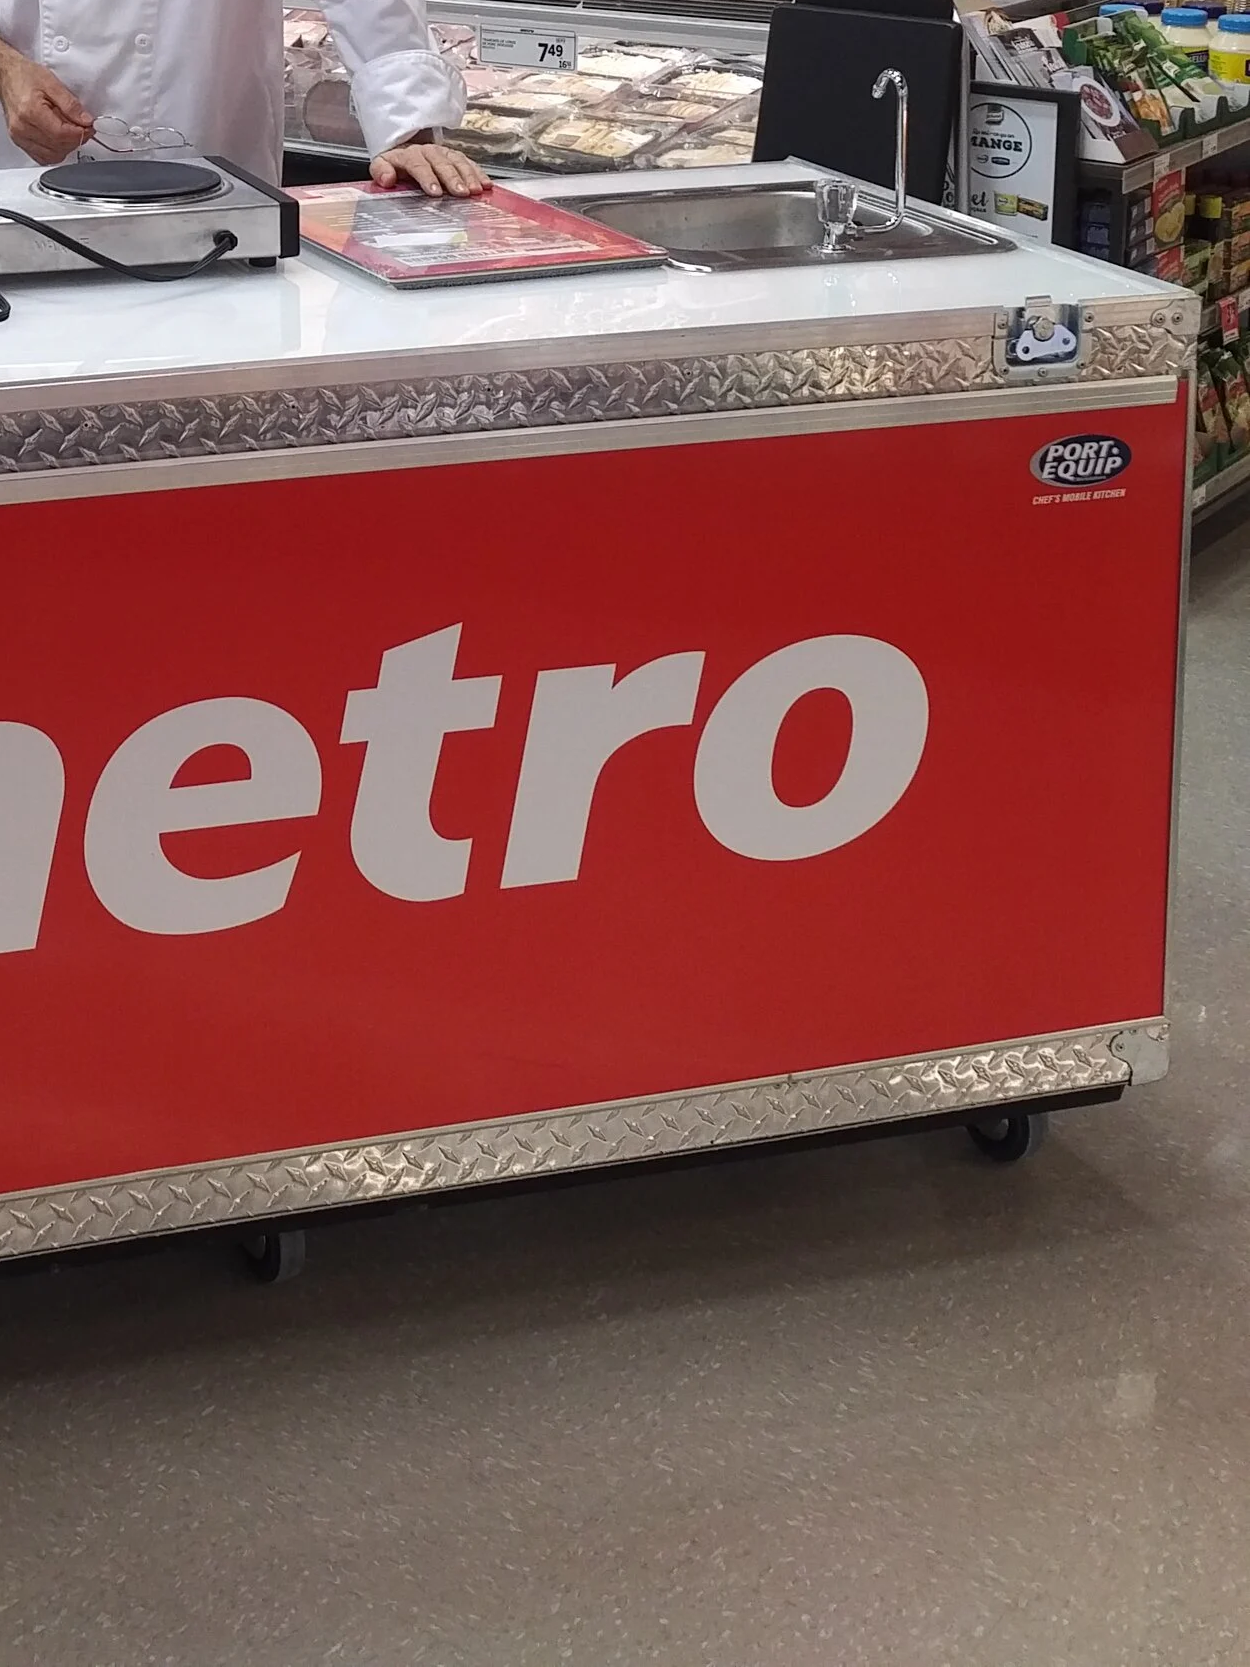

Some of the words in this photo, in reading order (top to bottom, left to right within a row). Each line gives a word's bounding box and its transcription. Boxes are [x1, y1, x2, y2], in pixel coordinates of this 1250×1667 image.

[1042, 456, 1123, 481] EQUIP
[1032, 494, 1061, 505] CHEF'S
[1062, 491, 1091, 502] MOBILE
[1092, 488, 1126, 500] KITCHEN
